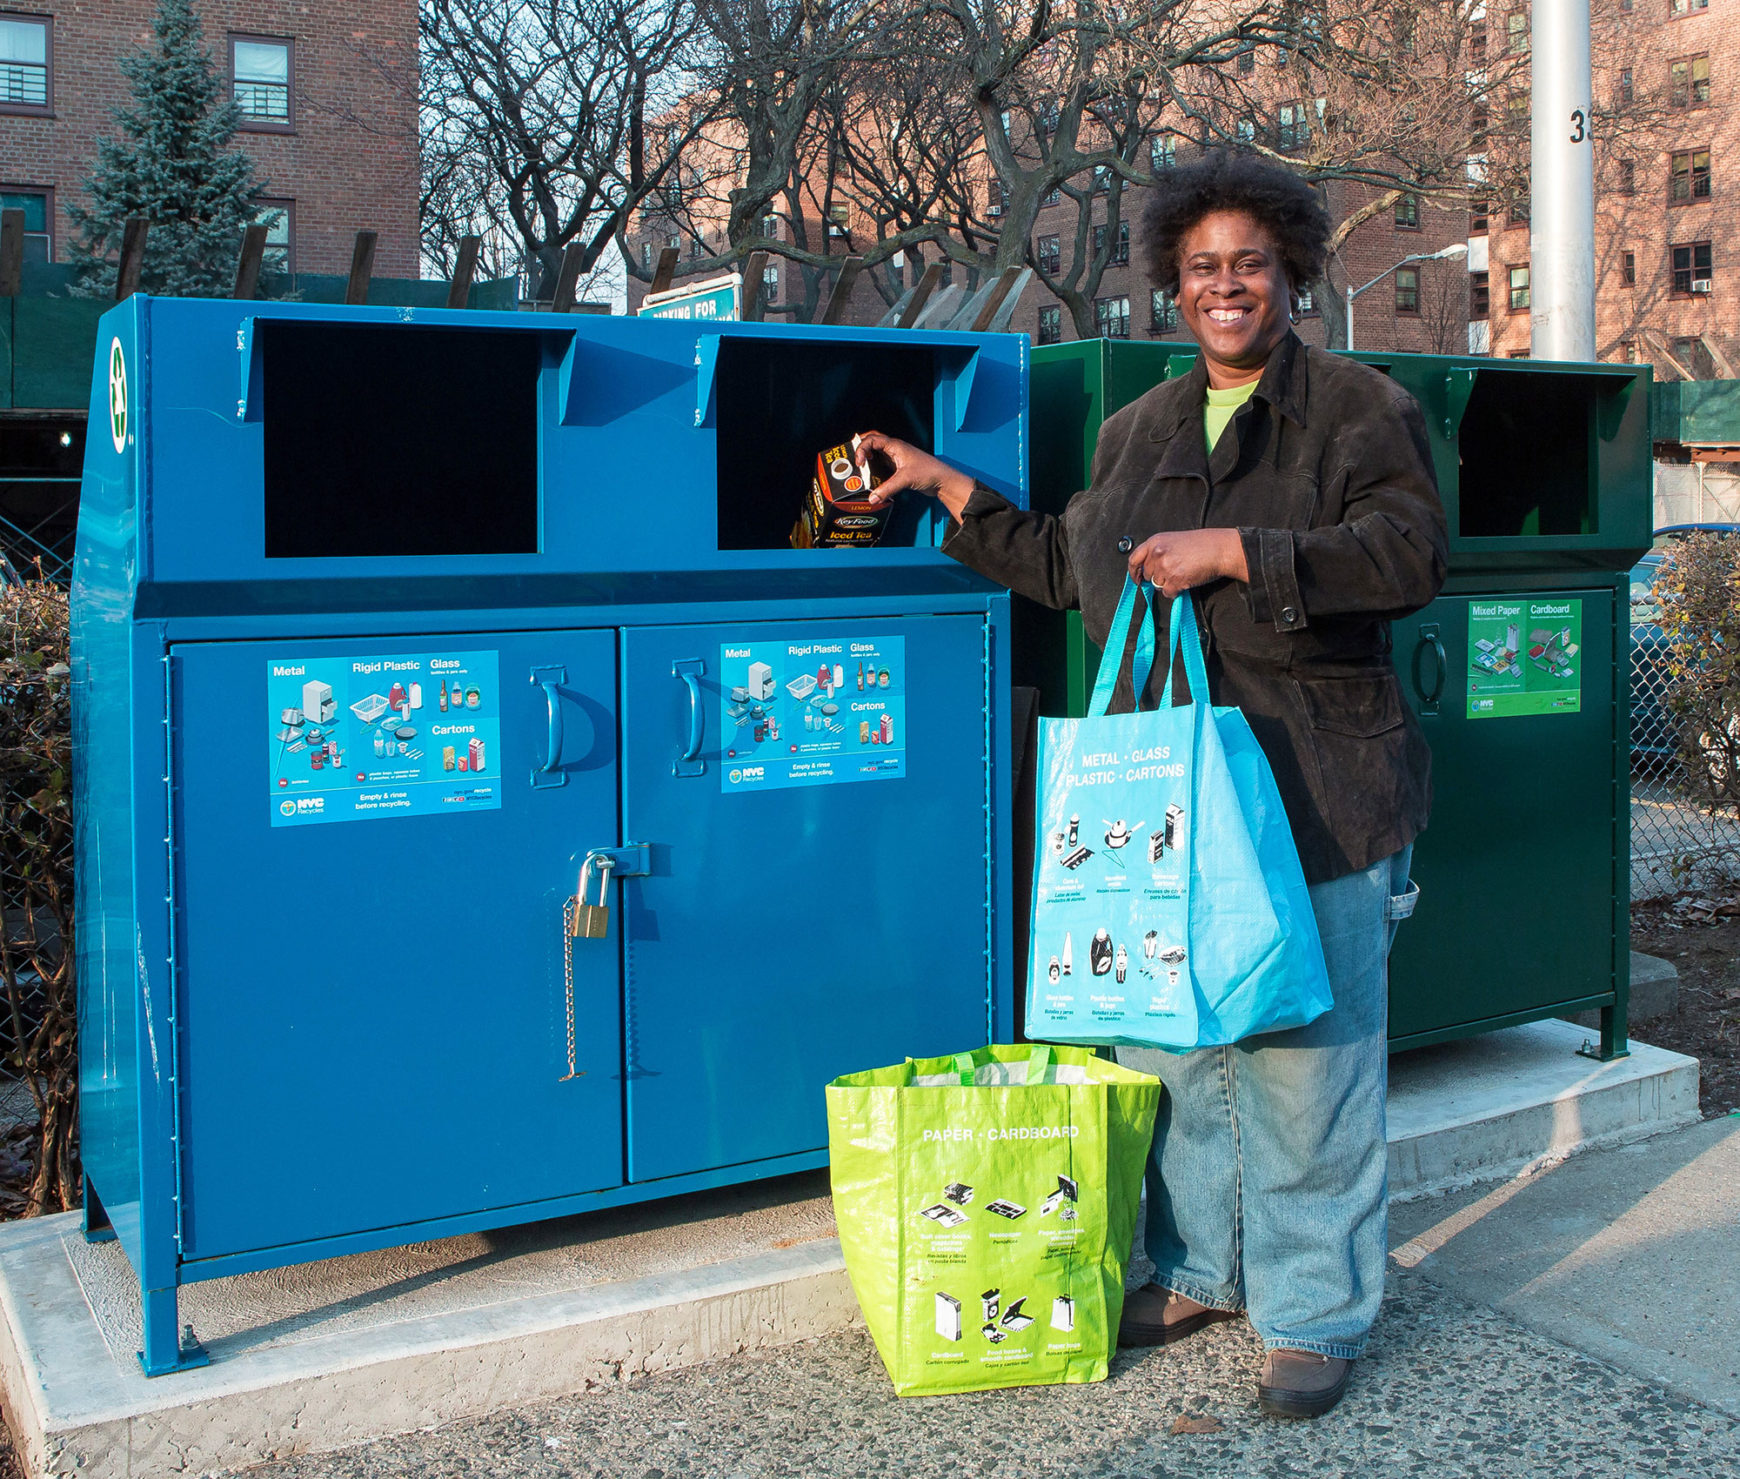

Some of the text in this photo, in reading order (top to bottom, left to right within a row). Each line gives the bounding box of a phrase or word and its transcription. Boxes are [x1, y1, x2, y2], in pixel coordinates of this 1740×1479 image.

[695, 300, 716, 318] FOR
[830, 531, 872, 539] Iced Tea
[1472, 605, 1520, 616] Mixed Paper
[1530, 604, 1570, 614] Cardboard
[788, 644, 842, 656] Rigid Plastic
[850, 643, 875, 652] Glass
[725, 649, 751, 658] Metal
[352, 660, 421, 674] Rigid Plastic
[430, 659, 460, 669] Glass
[273, 665, 305, 676] Metal
[851, 702, 886, 712] Cartons
[432, 724, 475, 735] Cartons
[1082, 746, 1171, 768] METAL GLASS
[743, 766, 765, 777] NYC
[792, 763, 810, 771] Empty
[1066, 763, 1185, 787] PLASTIC CARTONS
[297, 797, 325, 808] NYC
[360, 793, 382, 801] Empty
[297, 807, 324, 815] Recycles
[355, 802, 378, 810] before
[923, 1125, 1079, 1142] PAPER CARDBOARD
